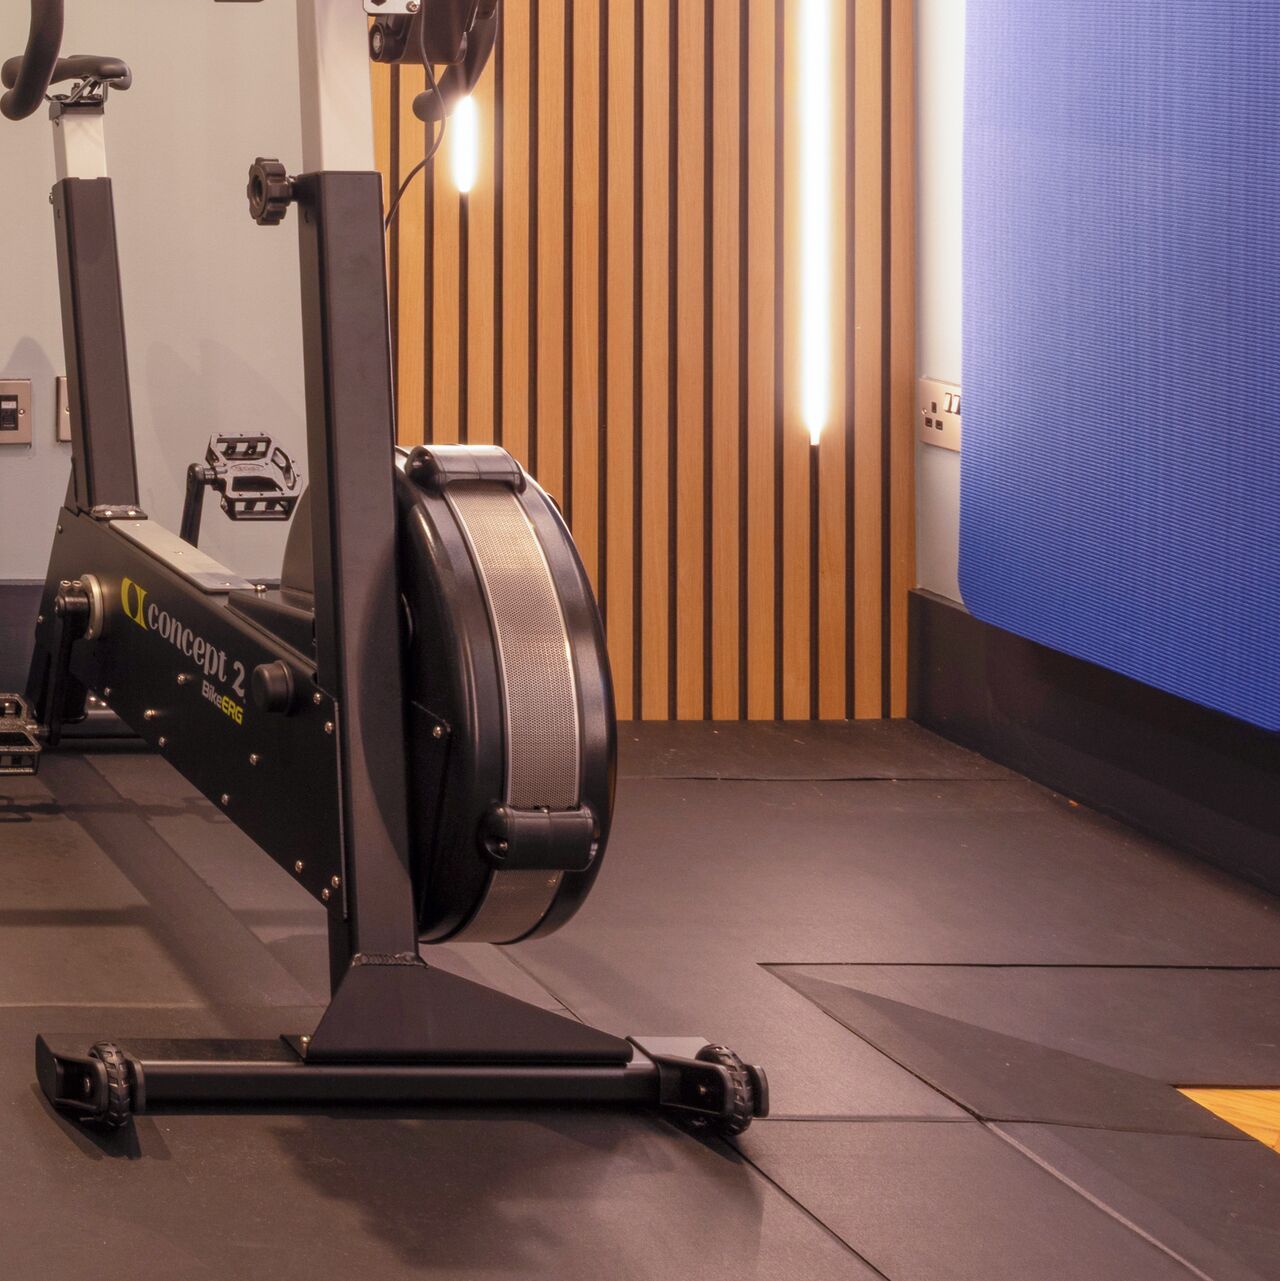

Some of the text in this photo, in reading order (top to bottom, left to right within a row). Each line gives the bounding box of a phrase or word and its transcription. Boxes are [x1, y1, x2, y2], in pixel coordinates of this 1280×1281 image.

[147, 603, 228, 682] concept
[233, 661, 246, 698] 2
[201, 680, 243, 725] BikeERG
